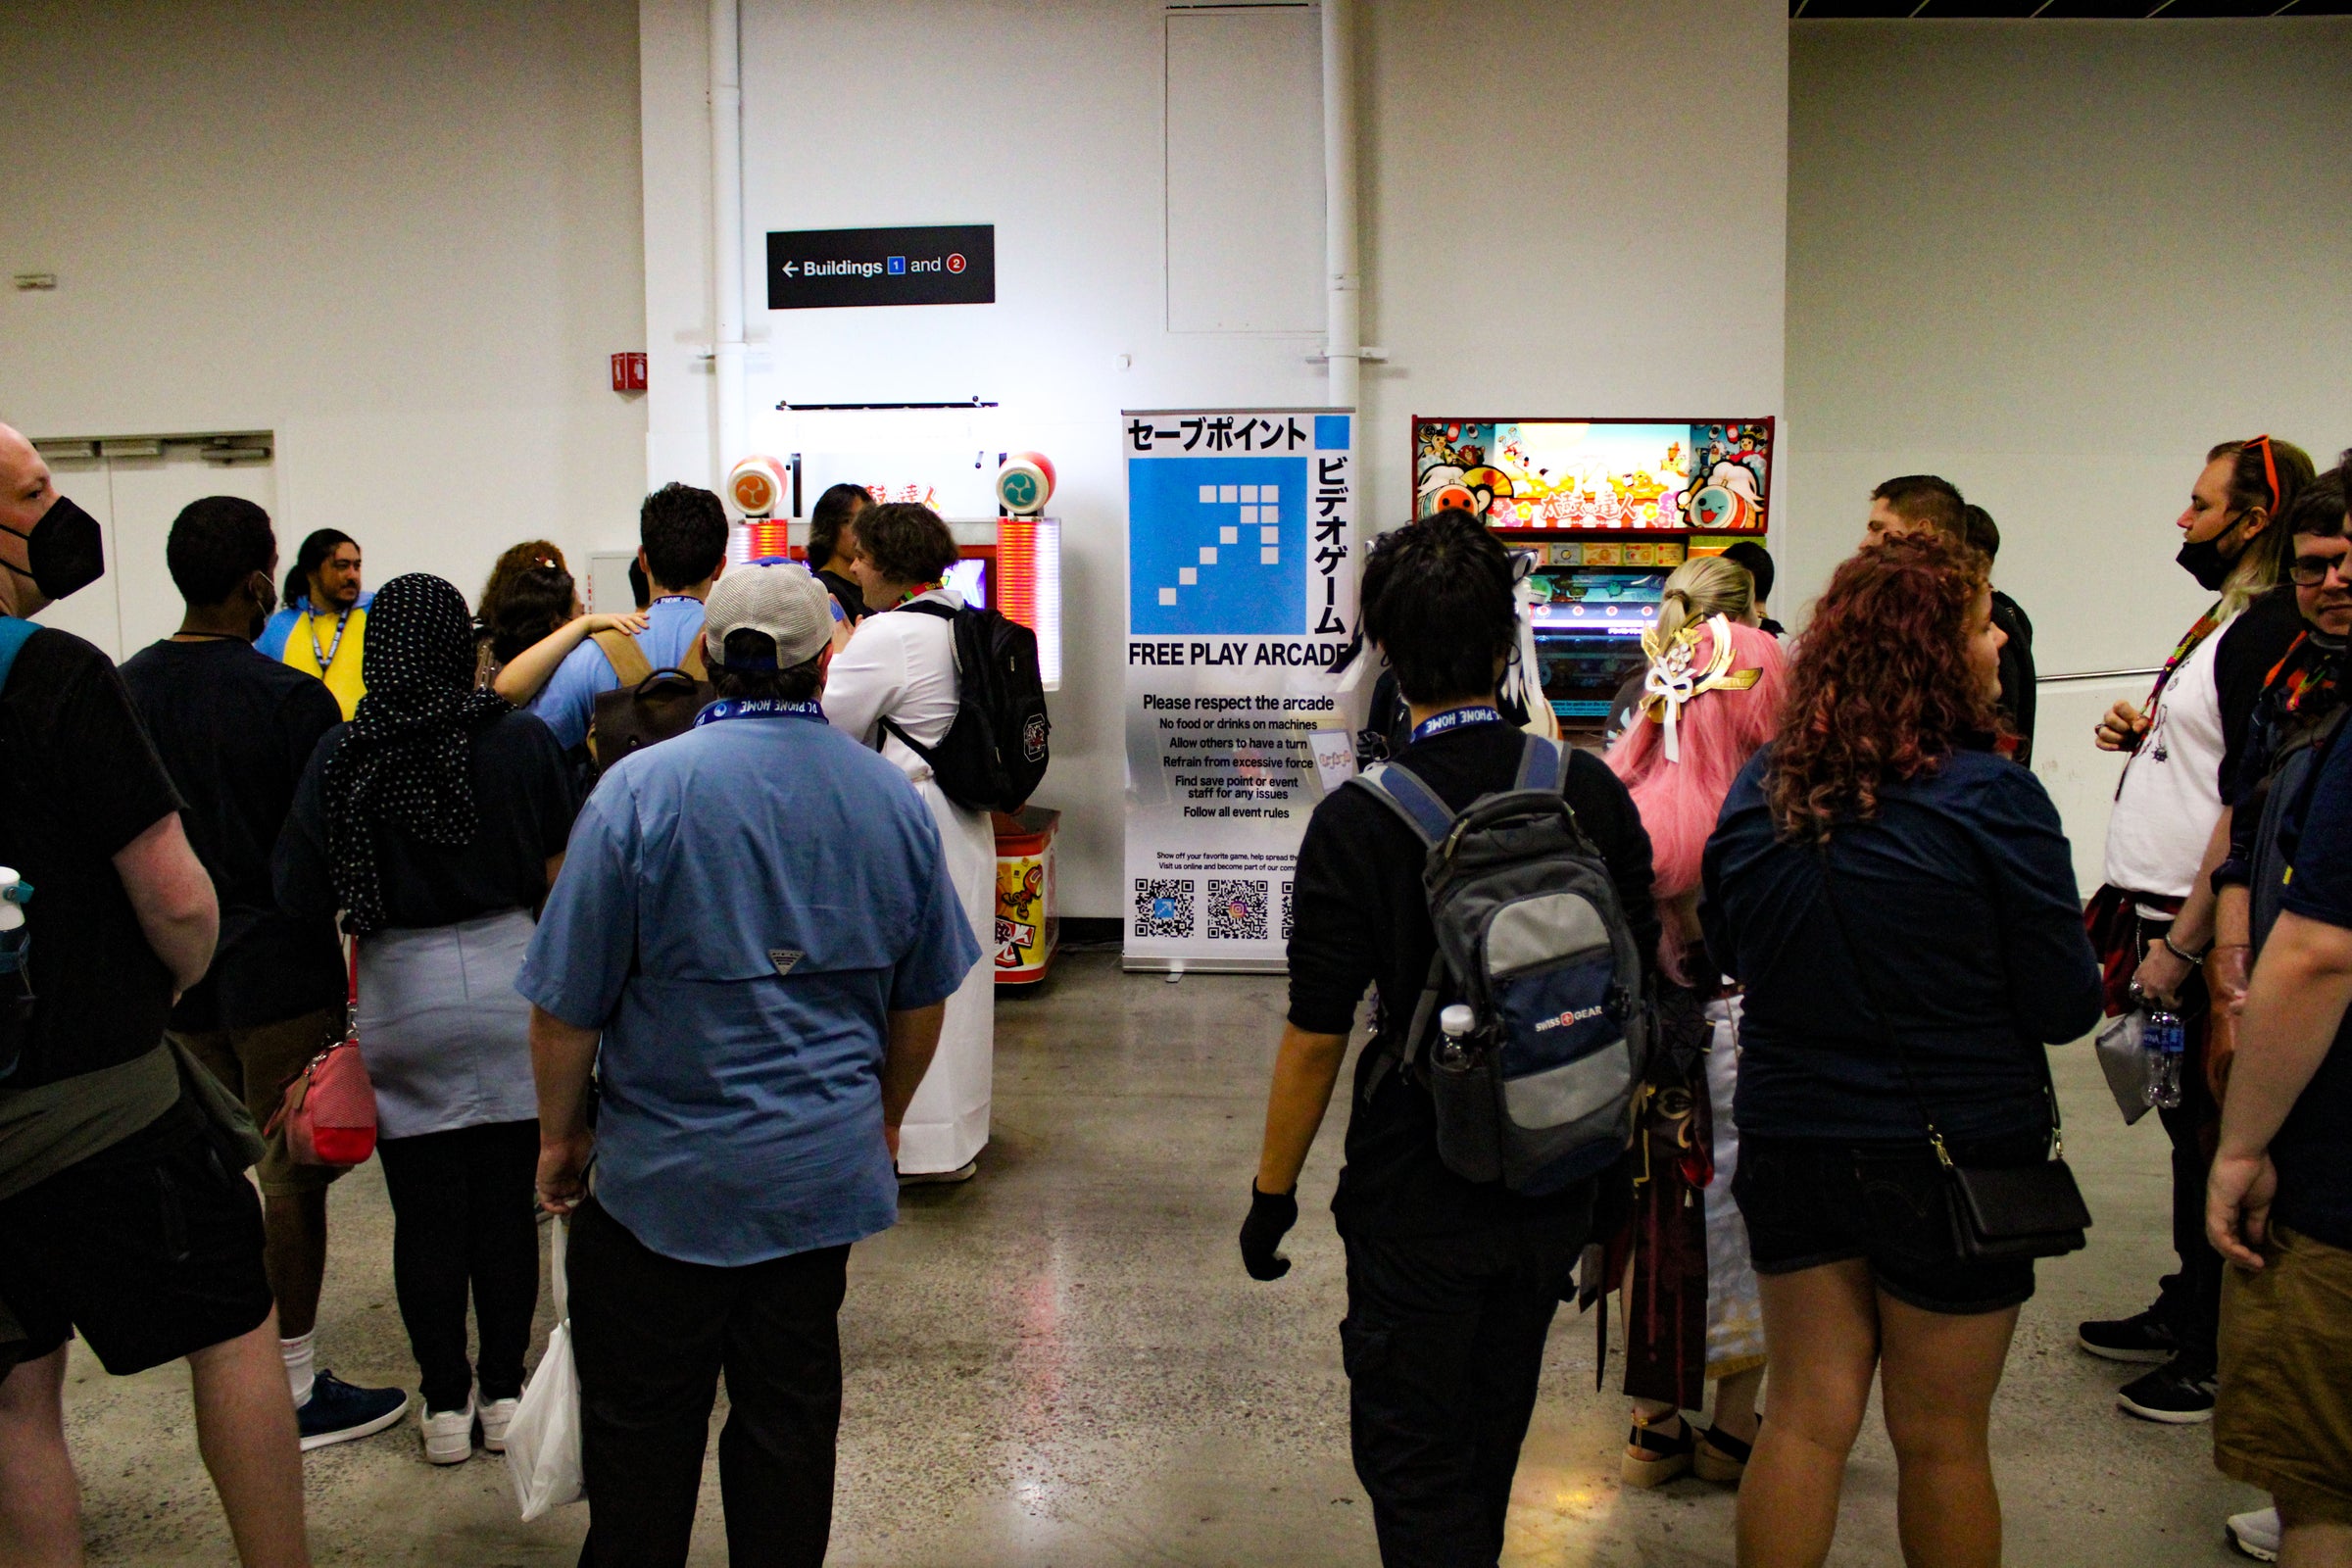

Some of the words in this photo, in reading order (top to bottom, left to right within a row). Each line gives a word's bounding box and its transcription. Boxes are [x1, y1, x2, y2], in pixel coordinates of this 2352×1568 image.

[804, 260, 883, 277] Buildings
[910, 257, 941, 272] and
[1128, 416, 1306, 451] セーブポイント
[1541, 490, 1638, 519] 太鼓の達人
[1314, 456, 1348, 635] ビデオゲーム
[1130, 643, 1185, 665] FREE
[1191, 643, 1248, 665] PLAY
[740, 700, 772, 713] HOME
[774, 699, 807, 712] PHONE
[1143, 694, 1191, 710] Please
[1195, 696, 1251, 712] respect
[1255, 695, 1280, 710] the
[1283, 696, 1335, 710] arcade
[1159, 717, 1175, 729] No
[1176, 717, 1201, 729] food
[1202, 720, 1215, 729] or
[1216, 718, 1250, 730] drinks
[1252, 720, 1266, 730] on
[1268, 719, 1317, 730] machines
[1425, 712, 1456, 733] HOME
[1459, 709, 1494, 723] PHONE
[1169, 737, 1198, 749] Allow
[1199, 737, 1233, 749] others
[1235, 738, 1248, 749] to
[1249, 738, 1275, 749] have
[1285, 739, 1307, 750] turn
[1163, 757, 1202, 767] Refrain
[1203, 757, 1231, 767] from
[1232, 758, 1283, 768] excessive
[1285, 758, 1314, 769] force
[1175, 775, 1198, 787] Find
[1200, 778, 1225, 787] save
[1226, 776, 1253, 790] point
[1255, 778, 1267, 788] or
[1269, 777, 1298, 788] event
[1188, 787, 1214, 798] staff
[1215, 787, 1232, 799] for
[1234, 789, 1254, 802] any
[1256, 788, 1289, 800] issues
[1184, 807, 1217, 817] Follow
[1218, 807, 1231, 817] all
[1232, 808, 1262, 818] event
[1263, 808, 1290, 818] rules
[1250, 853, 1264, 862] help
[1265, 854, 1289, 862] spread
[1535, 1016, 1561, 1033] SWISS
[1574, 1005, 1603, 1021] GEAR
